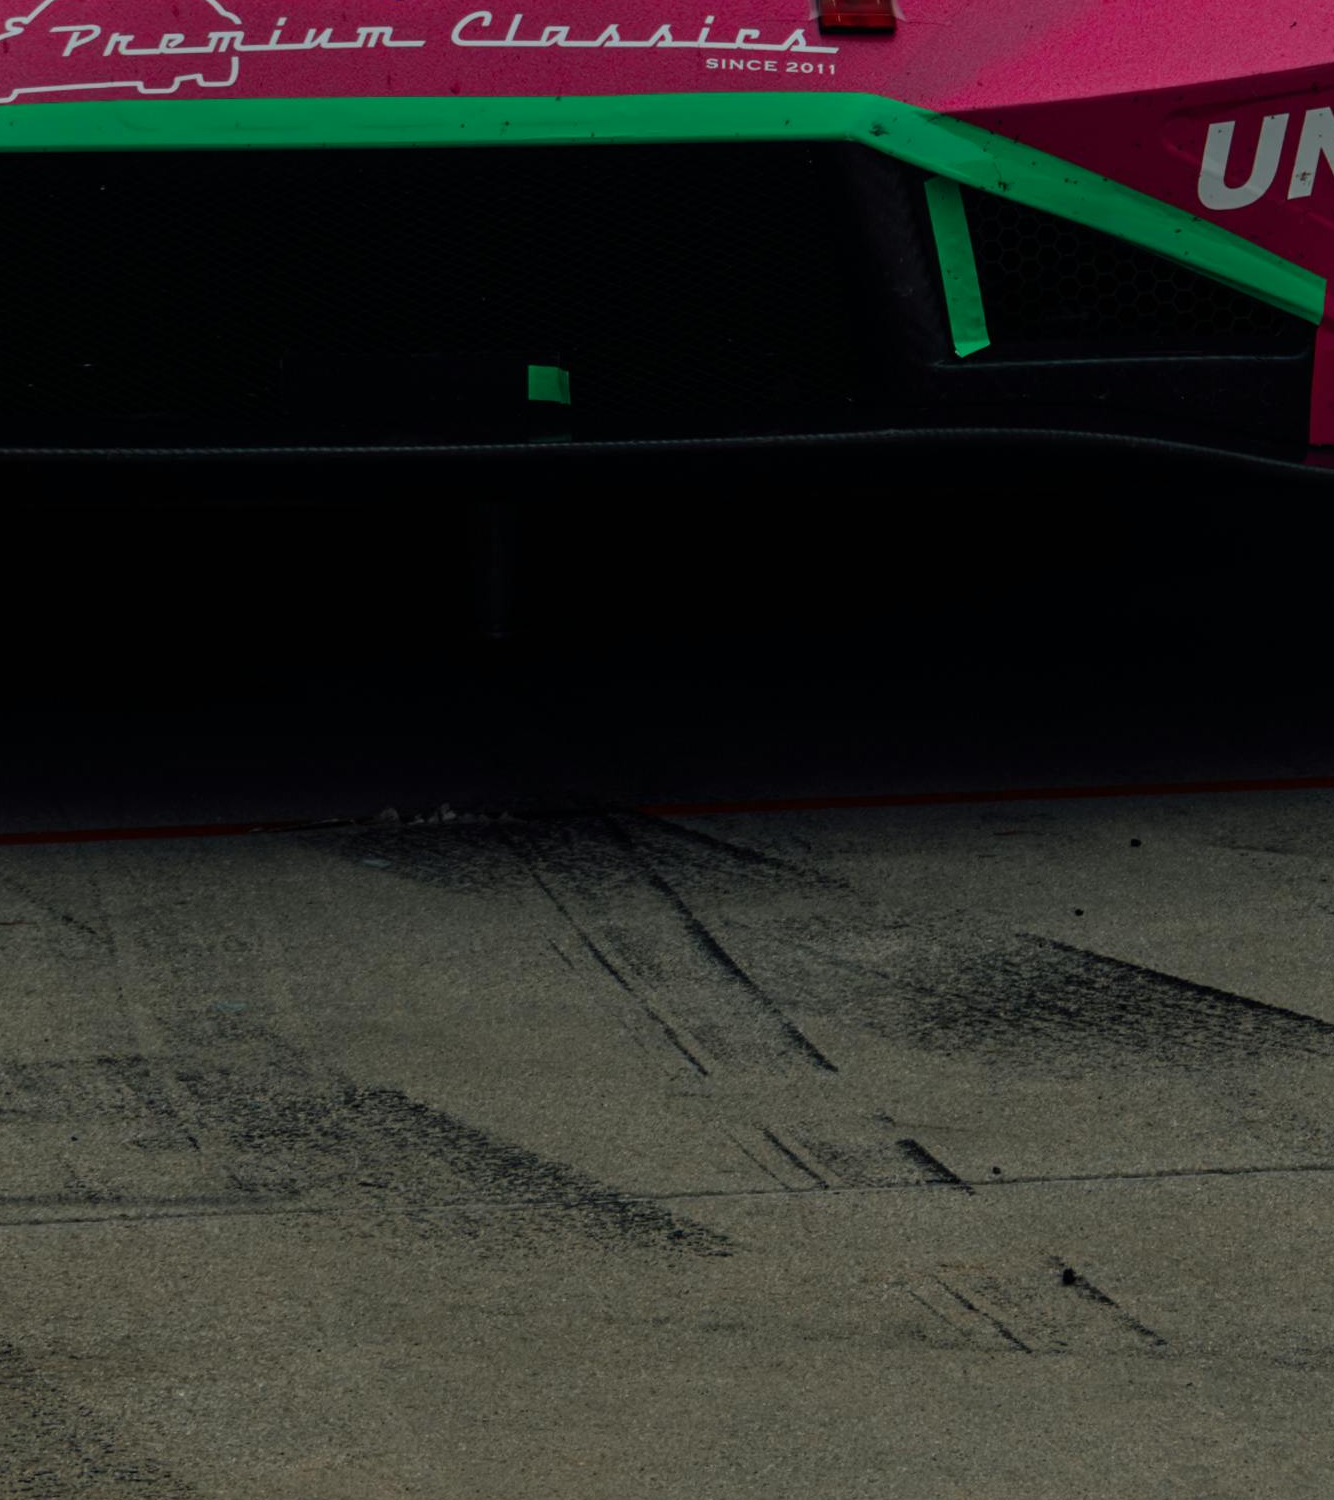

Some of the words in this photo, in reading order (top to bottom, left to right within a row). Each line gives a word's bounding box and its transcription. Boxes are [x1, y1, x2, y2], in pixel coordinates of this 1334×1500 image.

[50, 15, 426, 56] Premium
[451, 11, 839, 56] Classics
[706, 57, 779, 74] SINCE
[786, 59, 837, 75] 2011
